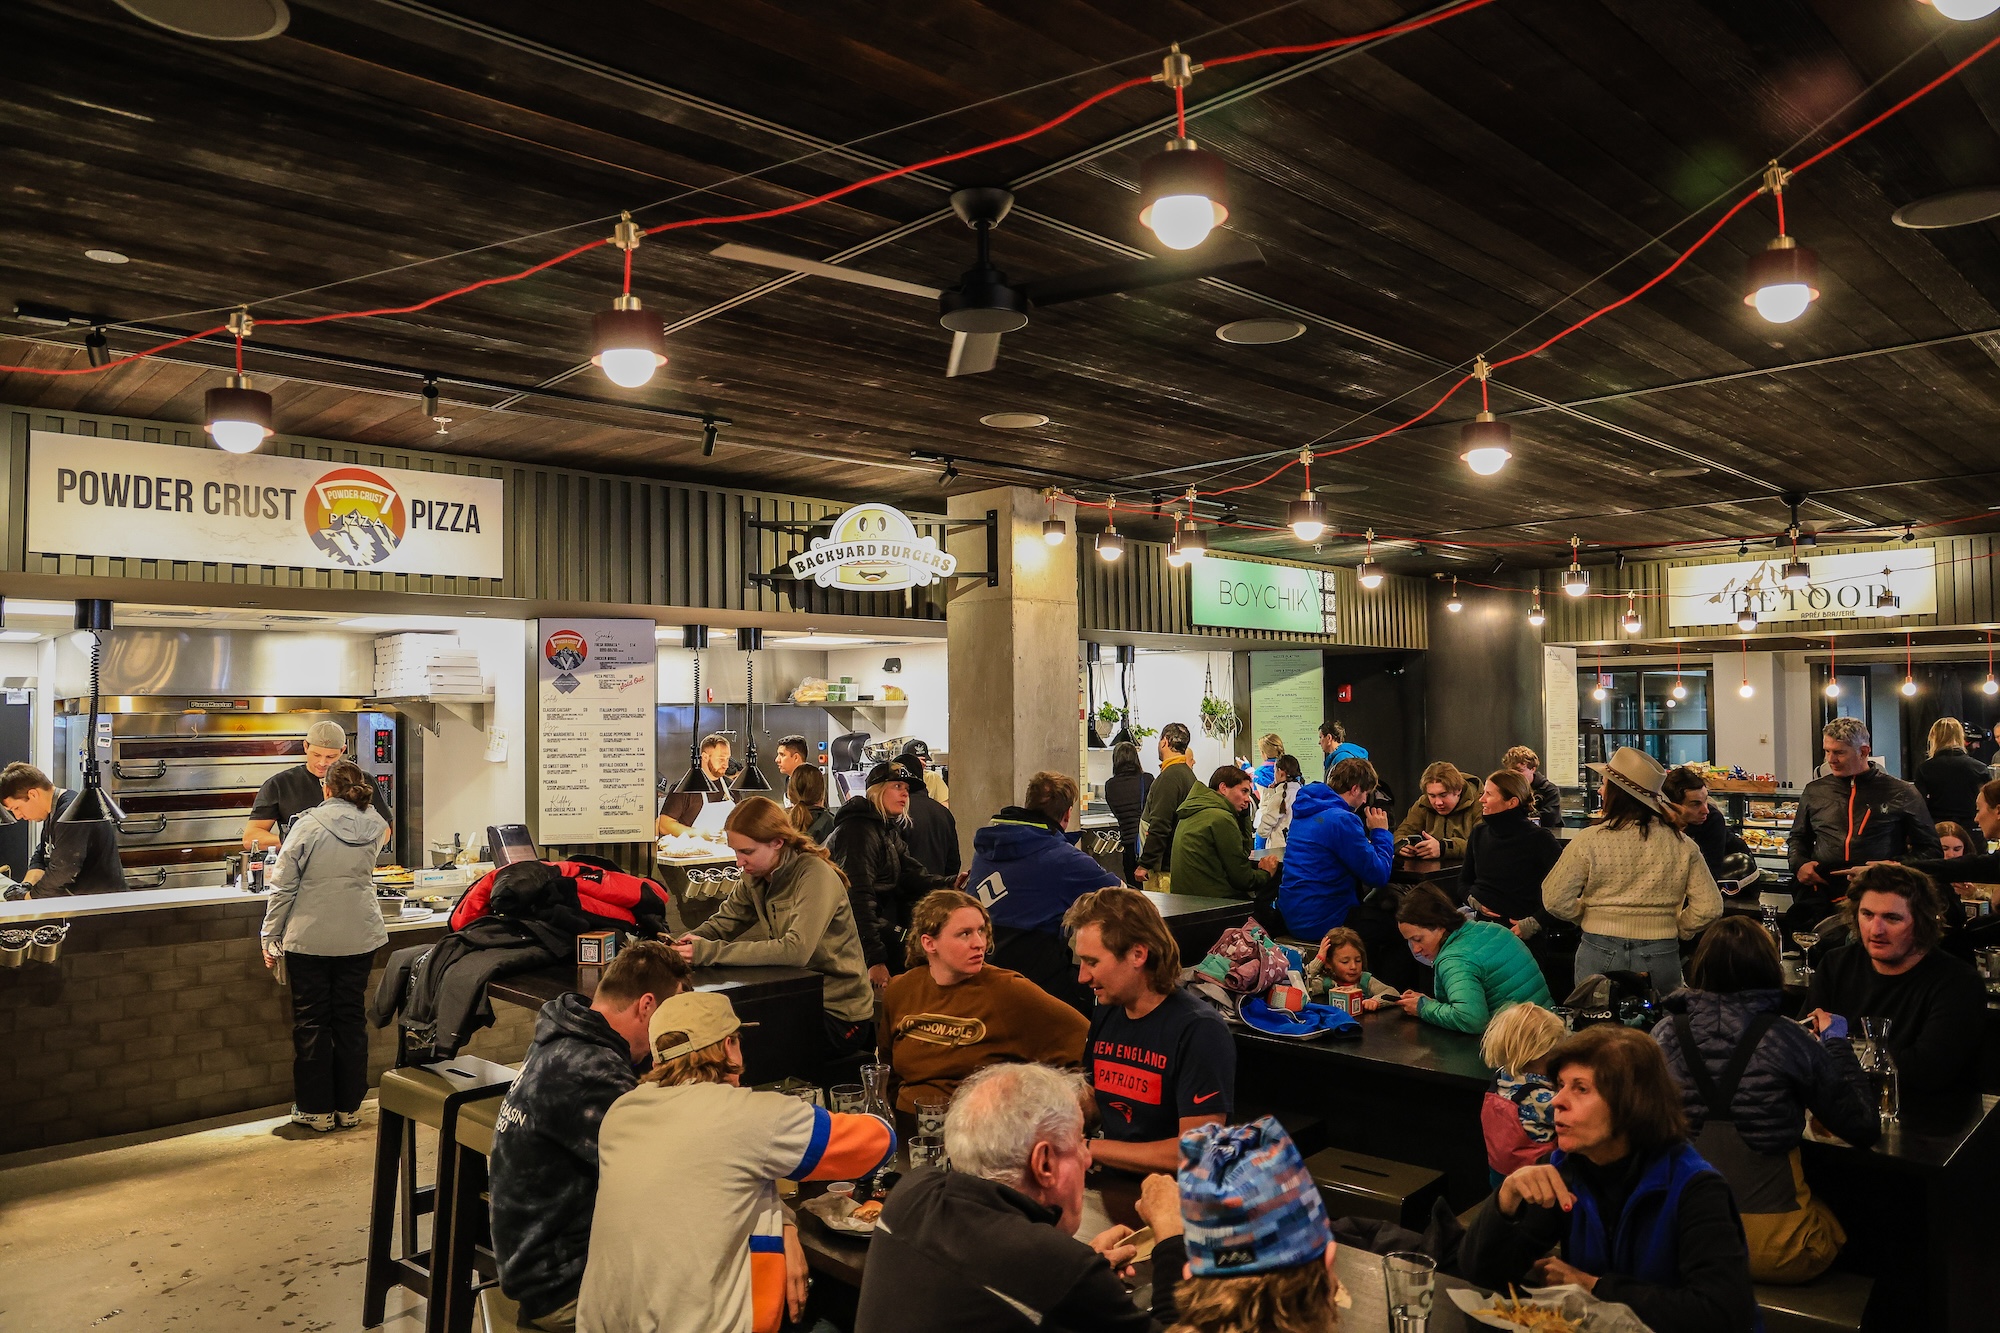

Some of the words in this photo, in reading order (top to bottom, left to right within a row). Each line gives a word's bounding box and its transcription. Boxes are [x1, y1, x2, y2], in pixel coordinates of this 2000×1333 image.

[57, 467, 193, 513] POWDER
[203, 481, 296, 521] CRUST
[327, 489, 358, 501] POWDER
[359, 490, 384, 504] CRUST
[329, 513, 384, 528] PIZZA
[411, 499, 481, 534] PIZZA
[794, 544, 877, 573] BACKYARD
[881, 544, 951, 571] BURGERS
[1219, 580, 1309, 612] BOYCHIK
[1822, 609, 1856, 618] BRASSERIE
[1093, 1040, 1114, 1056] NEW
[1116, 1043, 1167, 1069] ENGLAND
[1099, 1069, 1149, 1093] PATRIOTS
